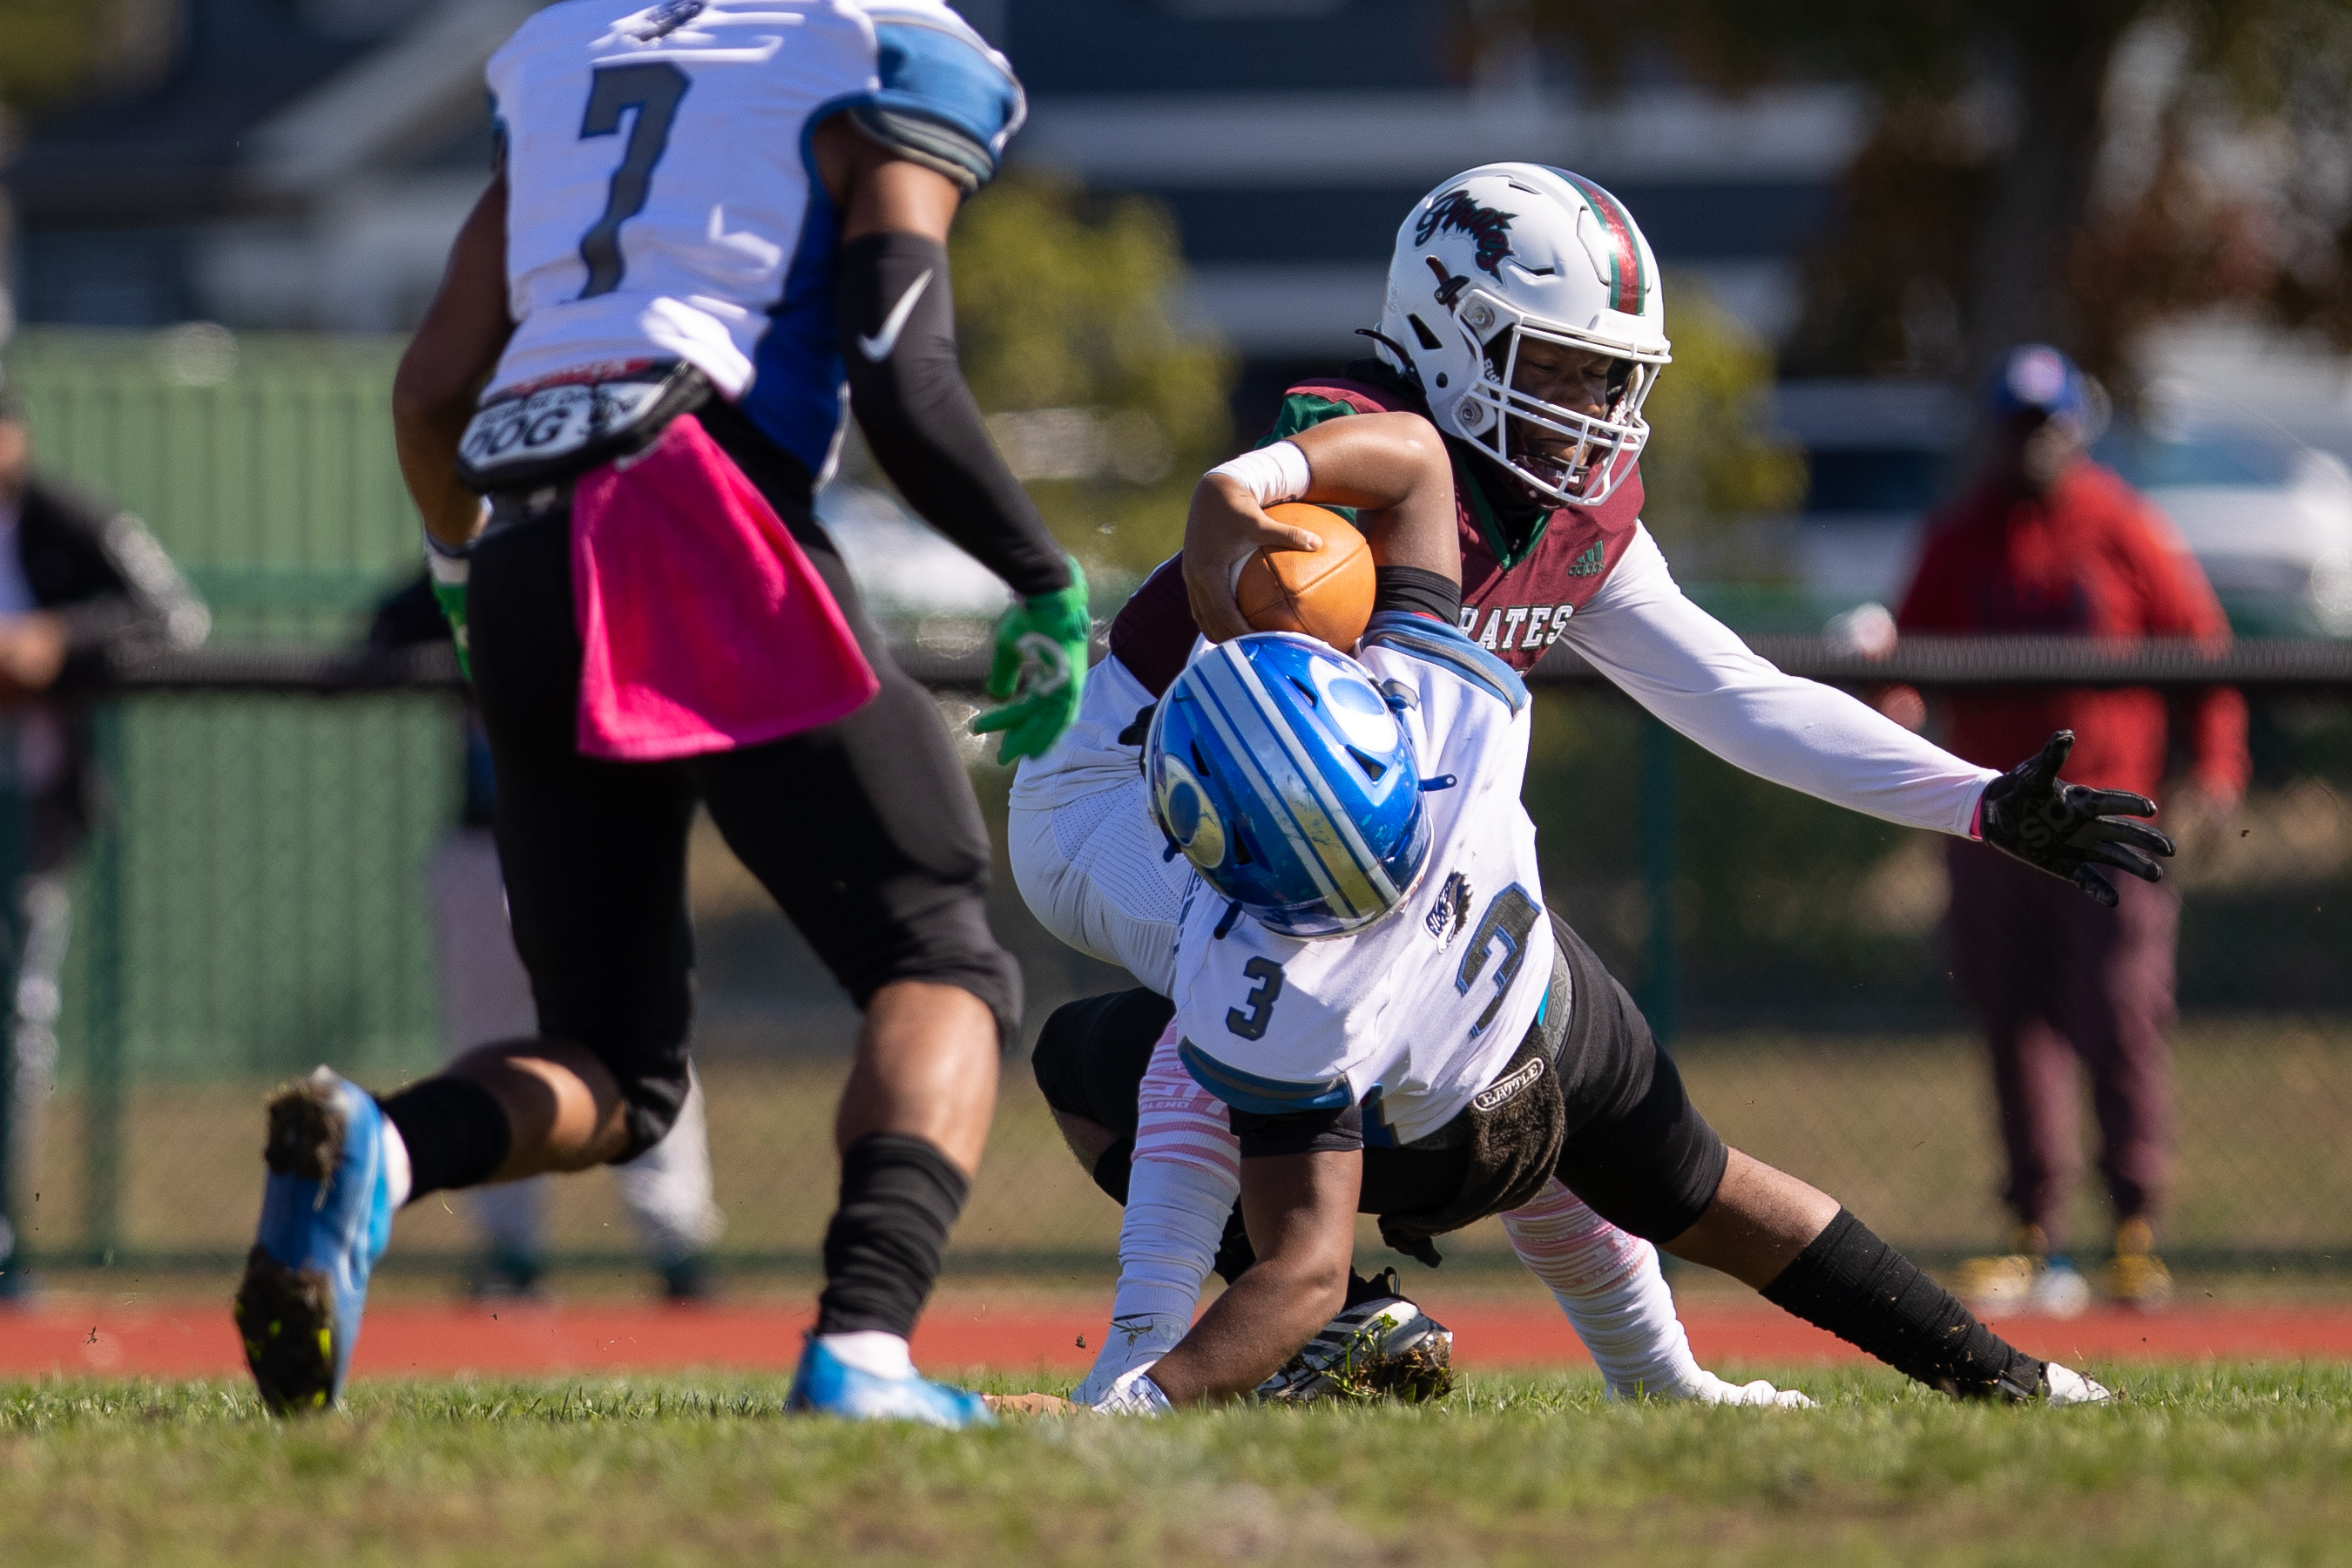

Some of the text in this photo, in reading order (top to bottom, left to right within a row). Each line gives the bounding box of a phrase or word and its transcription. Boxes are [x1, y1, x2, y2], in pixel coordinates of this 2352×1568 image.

[578, 60, 693, 301] 7
[1568, 562, 1605, 577] adidas
[1225, 955, 1286, 1042] 3
[1478, 1063, 1539, 1108] BATTLE
